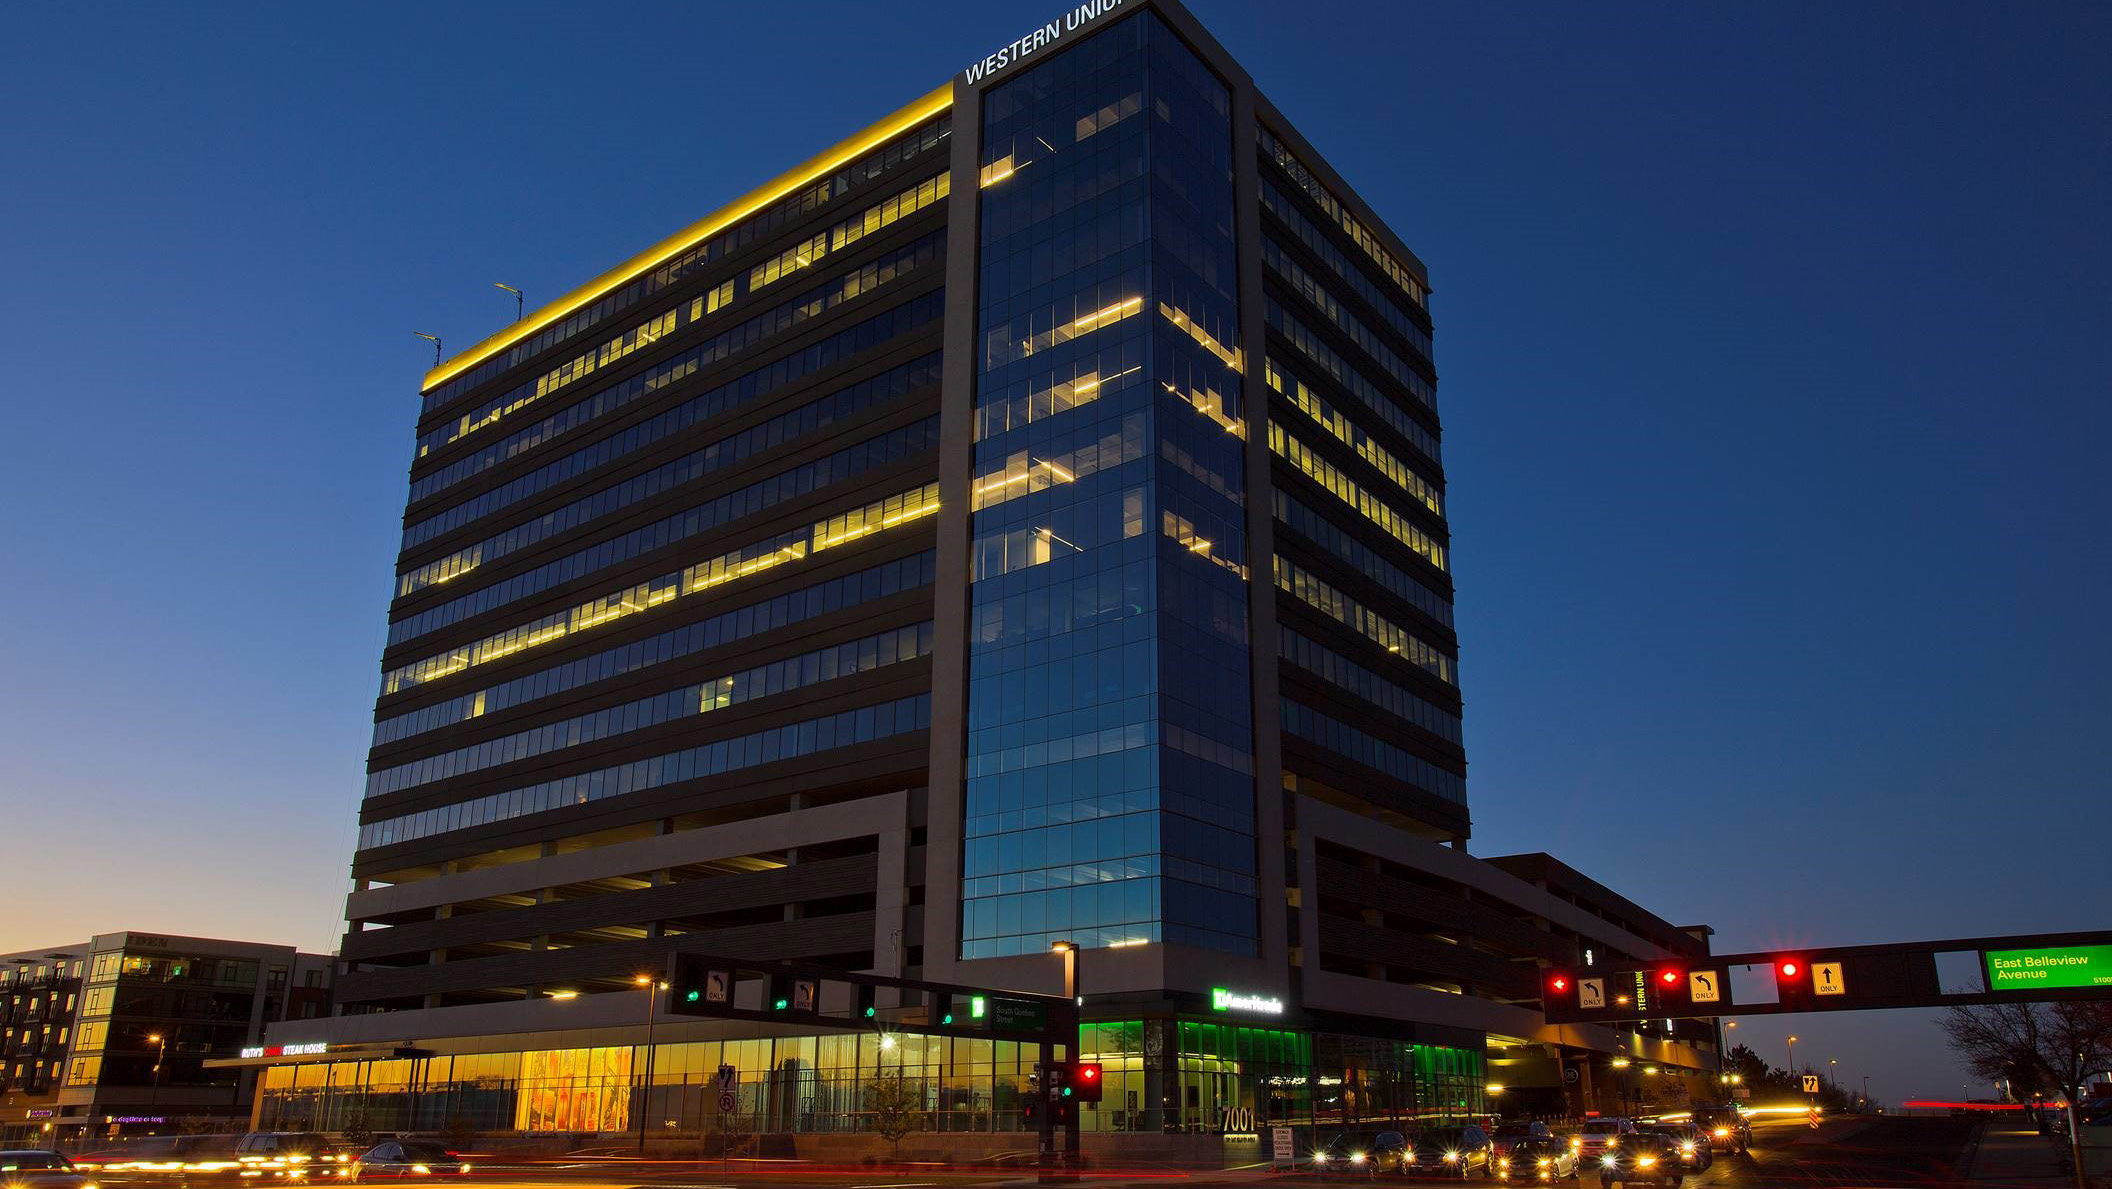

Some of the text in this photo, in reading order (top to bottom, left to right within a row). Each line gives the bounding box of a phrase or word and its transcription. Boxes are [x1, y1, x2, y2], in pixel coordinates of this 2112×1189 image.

[965, 0, 1122, 85] WESTERN UNIO
[1994, 955, 2088, 969] East Belleview
[1997, 969, 2047, 980] Avenue
[709, 992, 725, 1000] ONLY
[1695, 992, 1714, 1000] ONLY
[282, 1044, 304, 1056] STEAK
[304, 1042, 327, 1054] HOUSE
[1222, 1106, 1254, 1132] 7001
